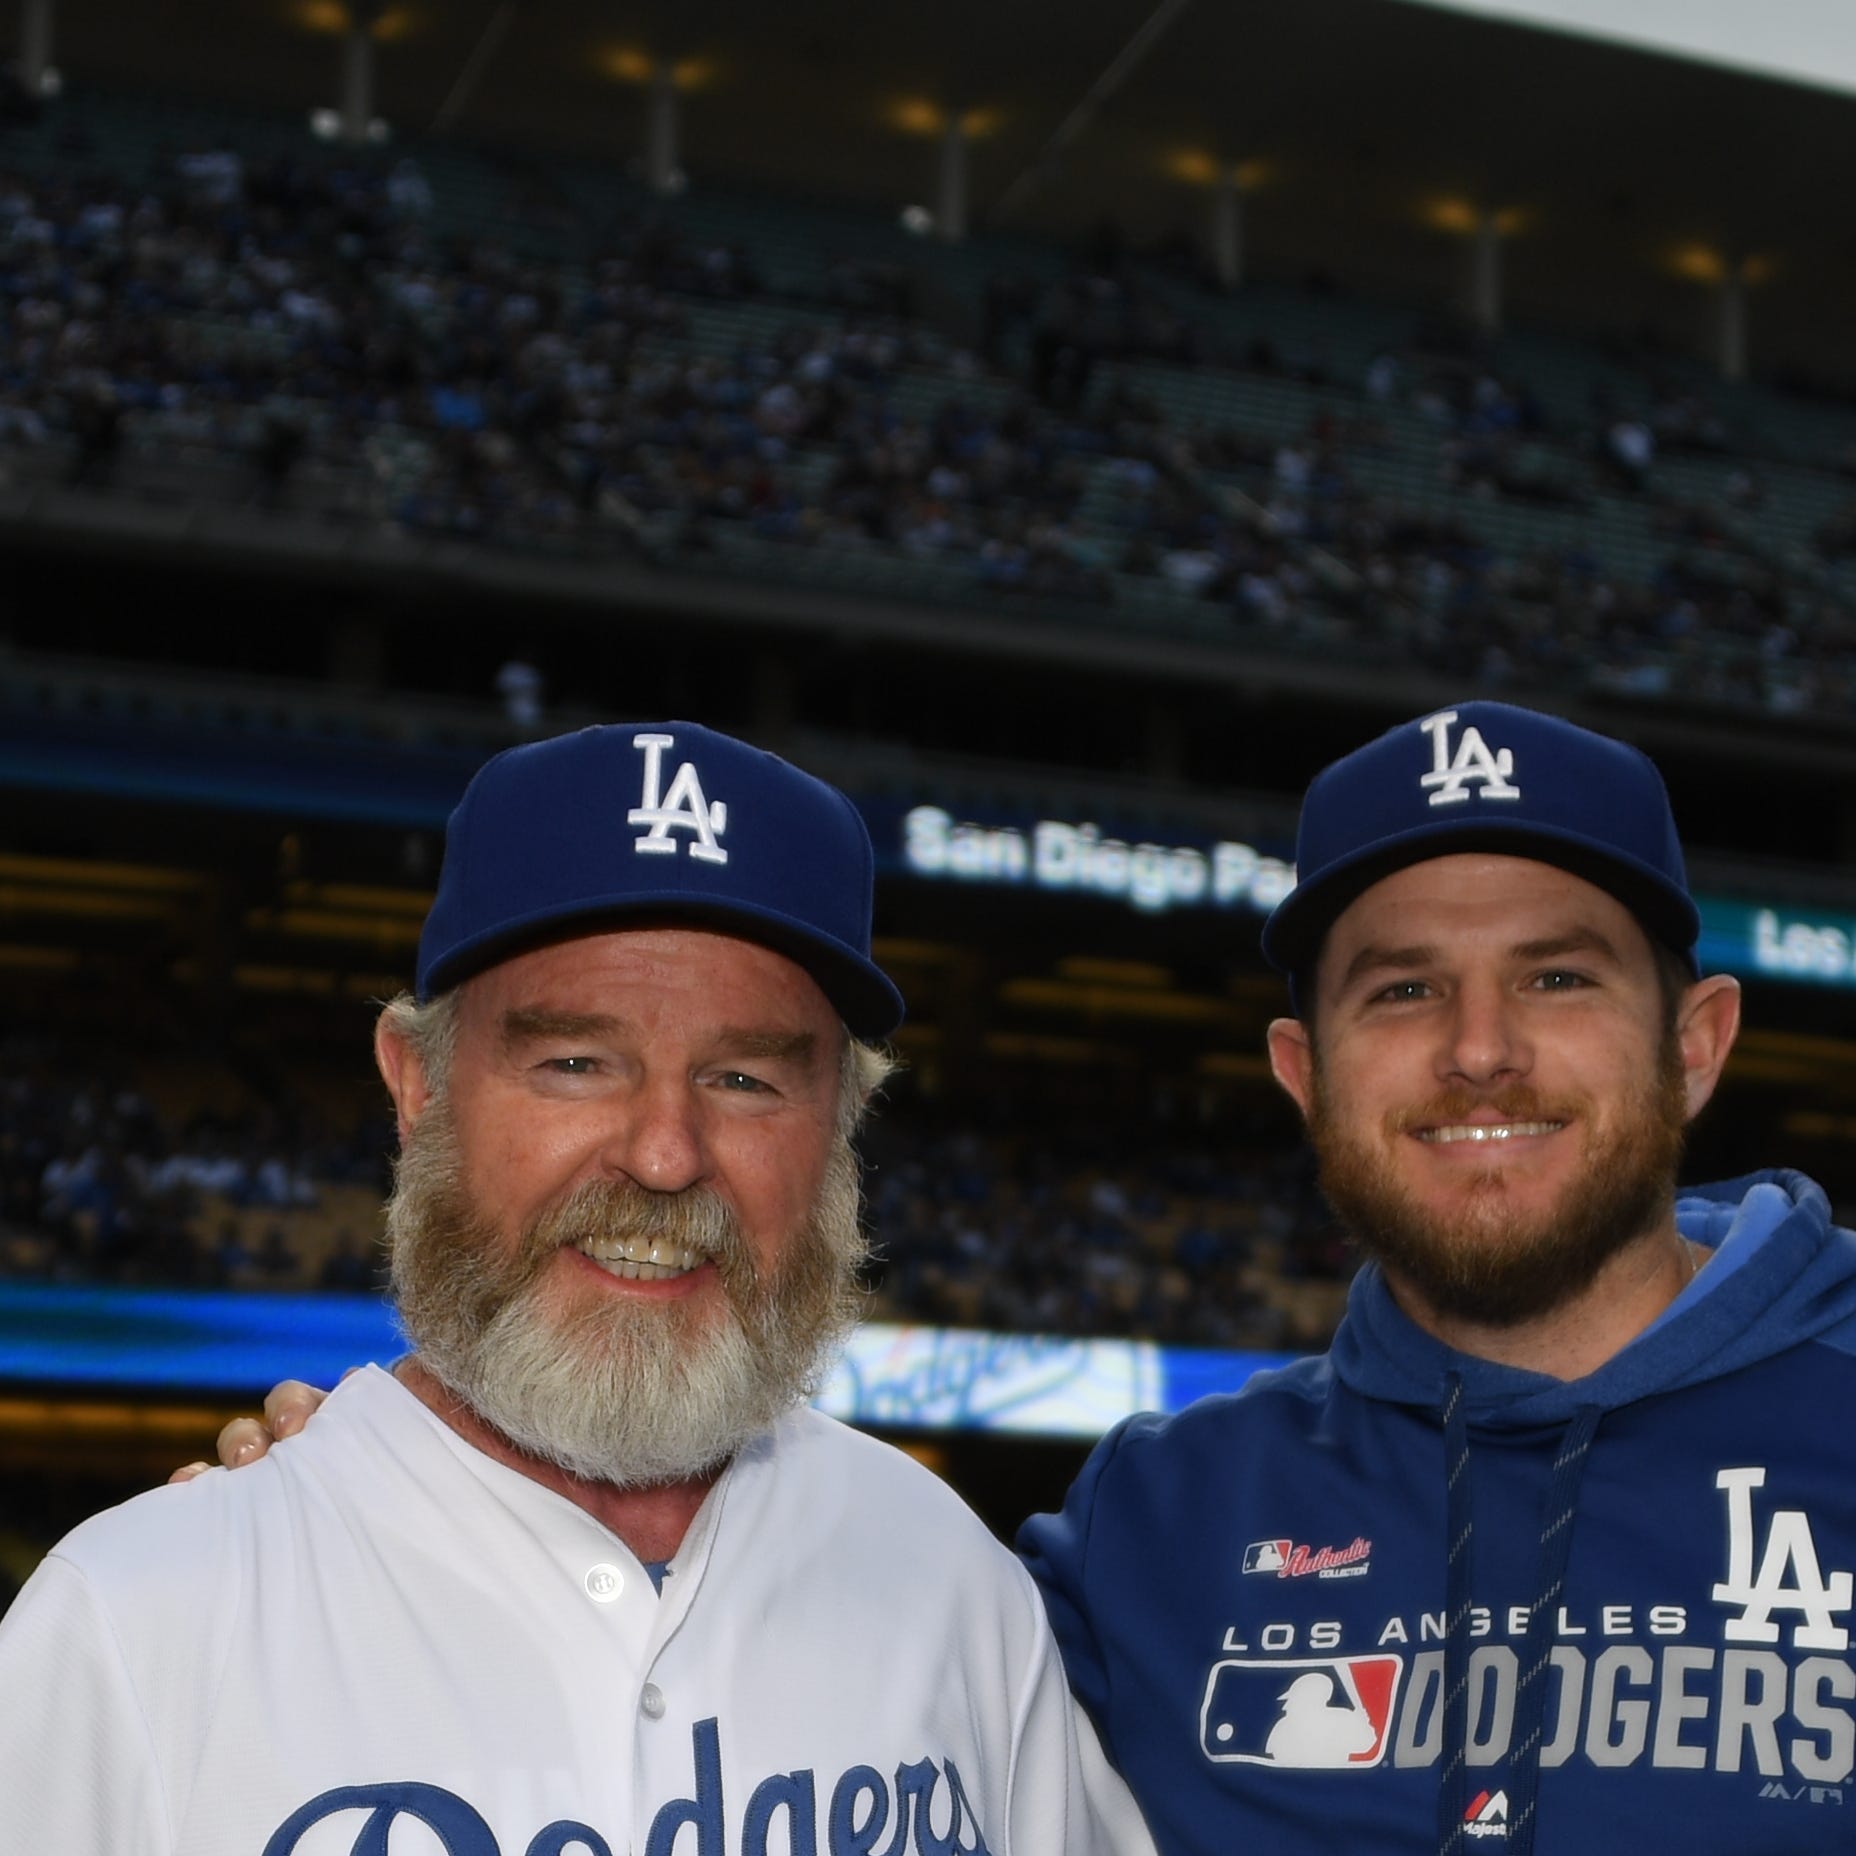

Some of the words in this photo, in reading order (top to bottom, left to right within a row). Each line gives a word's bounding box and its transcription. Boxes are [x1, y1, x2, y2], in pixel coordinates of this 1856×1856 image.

[627, 733, 728, 865] LA
[1420, 710, 1520, 806] LA
[906, 806, 1027, 877] San
[1034, 820, 1209, 913] Diego
[1755, 909, 1849, 975] Los
[1711, 1466, 1855, 1650] LA
[1222, 1620, 1343, 1652] LOS
[1378, 1605, 1688, 1647] ANGELES
